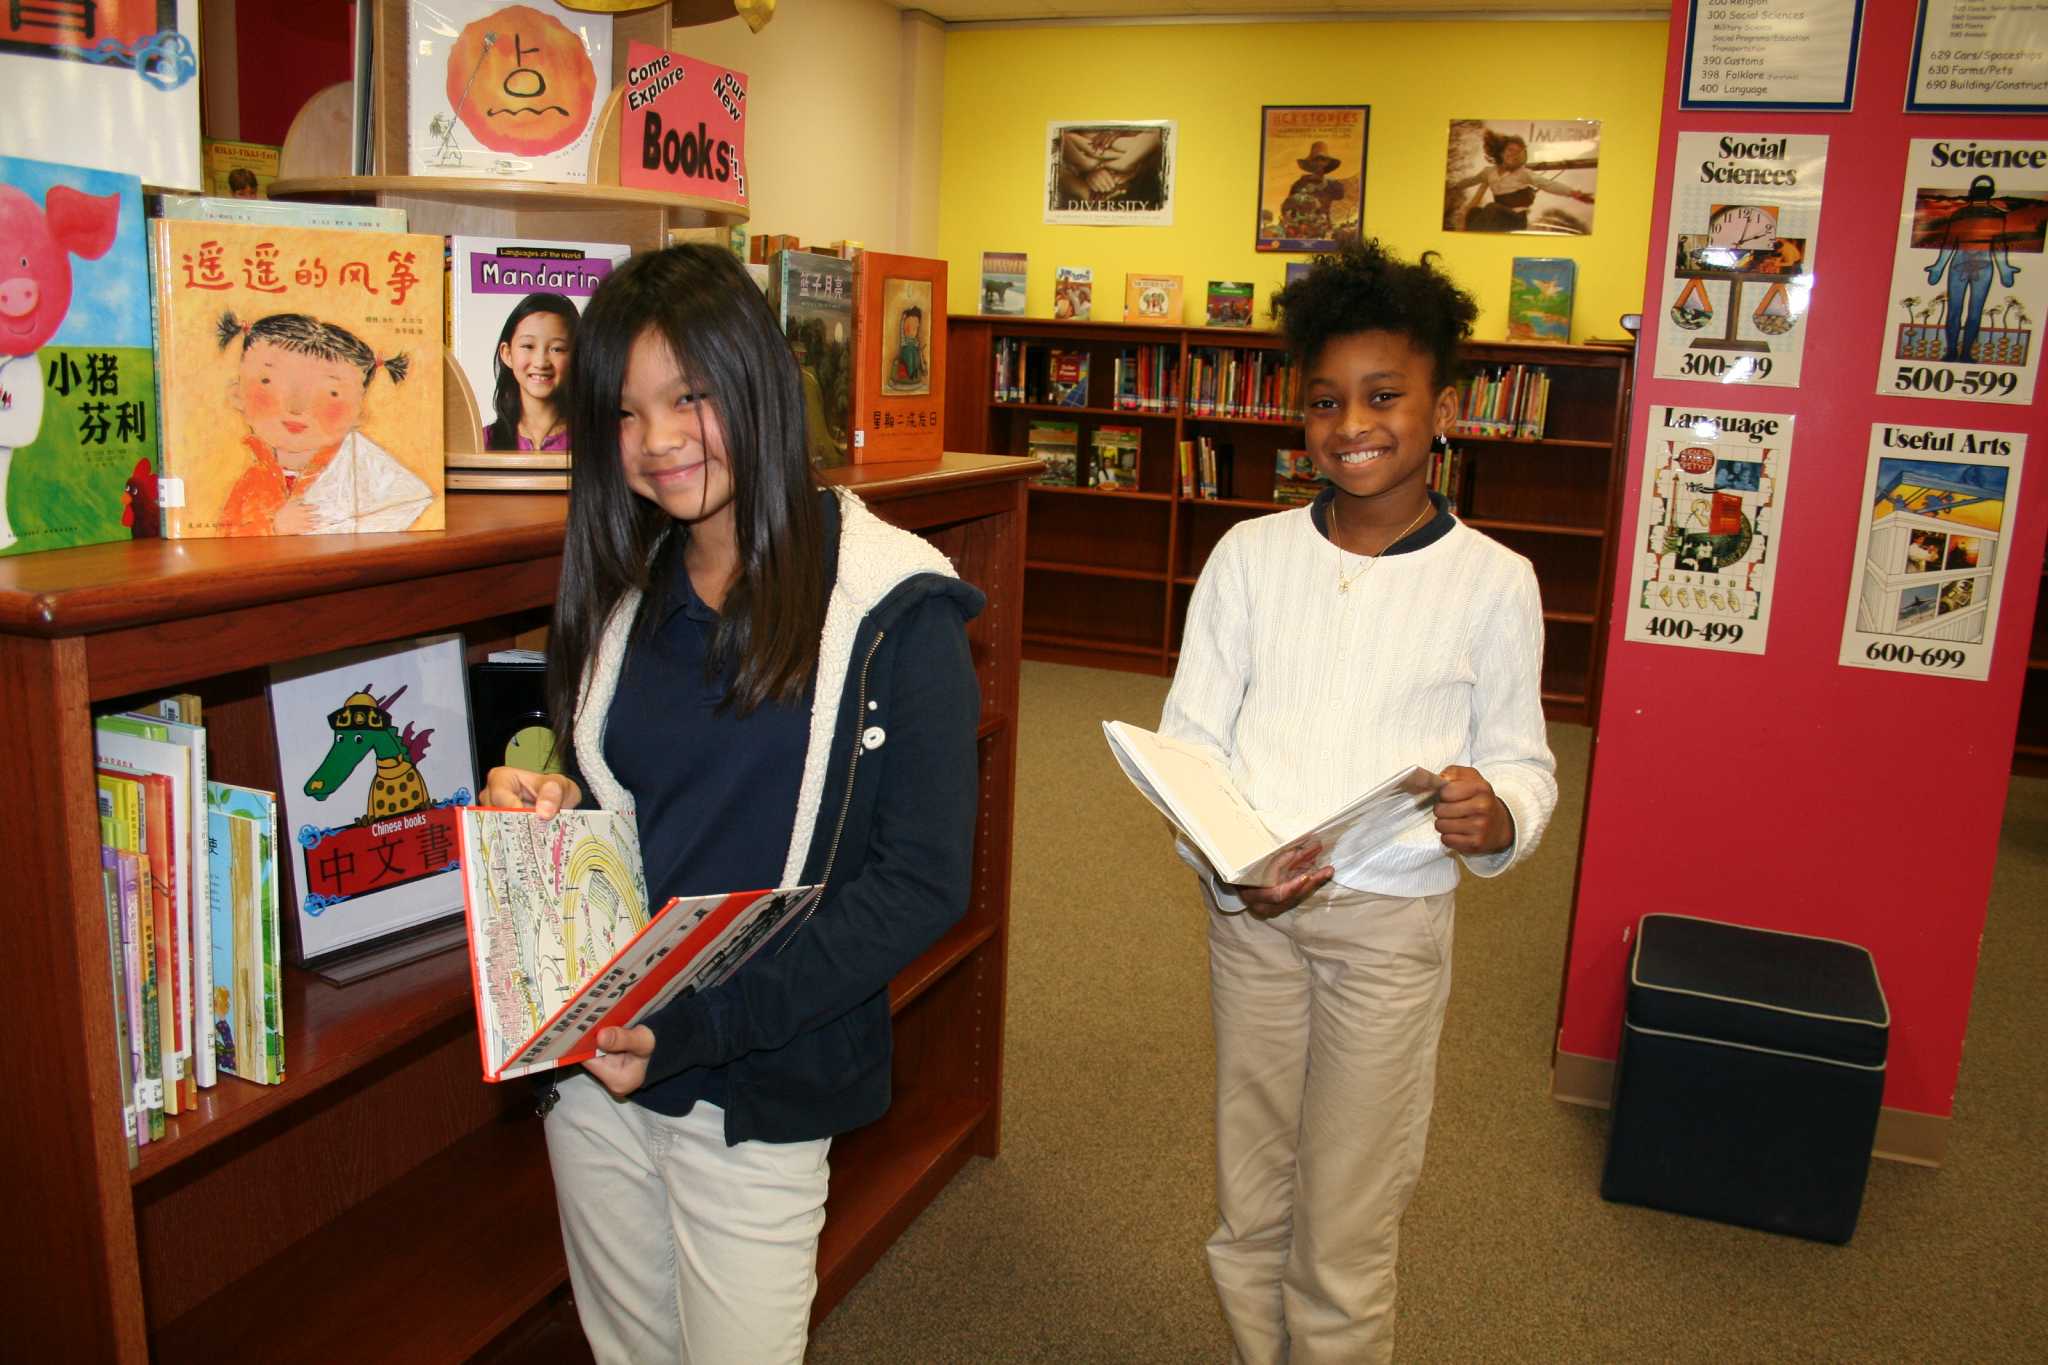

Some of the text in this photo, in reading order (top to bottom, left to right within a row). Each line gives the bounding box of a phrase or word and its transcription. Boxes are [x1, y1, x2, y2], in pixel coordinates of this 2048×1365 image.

[1707, 10, 1805, 20] 300 Social Sciences
[1703, 56, 1764, 66] 390 Customs
[1930, 50, 1952, 60] 629
[628, 54, 671, 86] Come
[1701, 70, 1720, 80] 398
[1725, 70, 1765, 80] Folklore
[1928, 65, 1949, 75] 630
[628, 67, 685, 112] Explore
[1699, 84, 1768, 96] 400 Language
[1926, 80, 1947, 90] 690
[712, 77, 741, 121] New
[1719, 136, 1787, 160] Social
[1931, 142, 2047, 169] Science
[1700, 161, 1798, 186] Sciences
[1068, 200, 1150, 211] DIVERSITY
[500, 248, 539, 259] Languages
[182, 240, 420, 305] 遥遥的风筝
[481, 261, 600, 290] Mandarin
[47, 352, 119, 397] 小猪
[1680, 353, 1773, 379] 300-9
[1895, 366, 2018, 396] 500-599
[78, 401, 146, 445] 芬利
[1664, 407, 1779, 443] Lanuage
[1883, 427, 2011, 456] Useful Arts
[1646, 616, 1744, 644] 400-499
[1866, 641, 1966, 669] 600-699
[372, 813, 427, 838] Chinese books
[320, 823, 453, 895] 中文書
